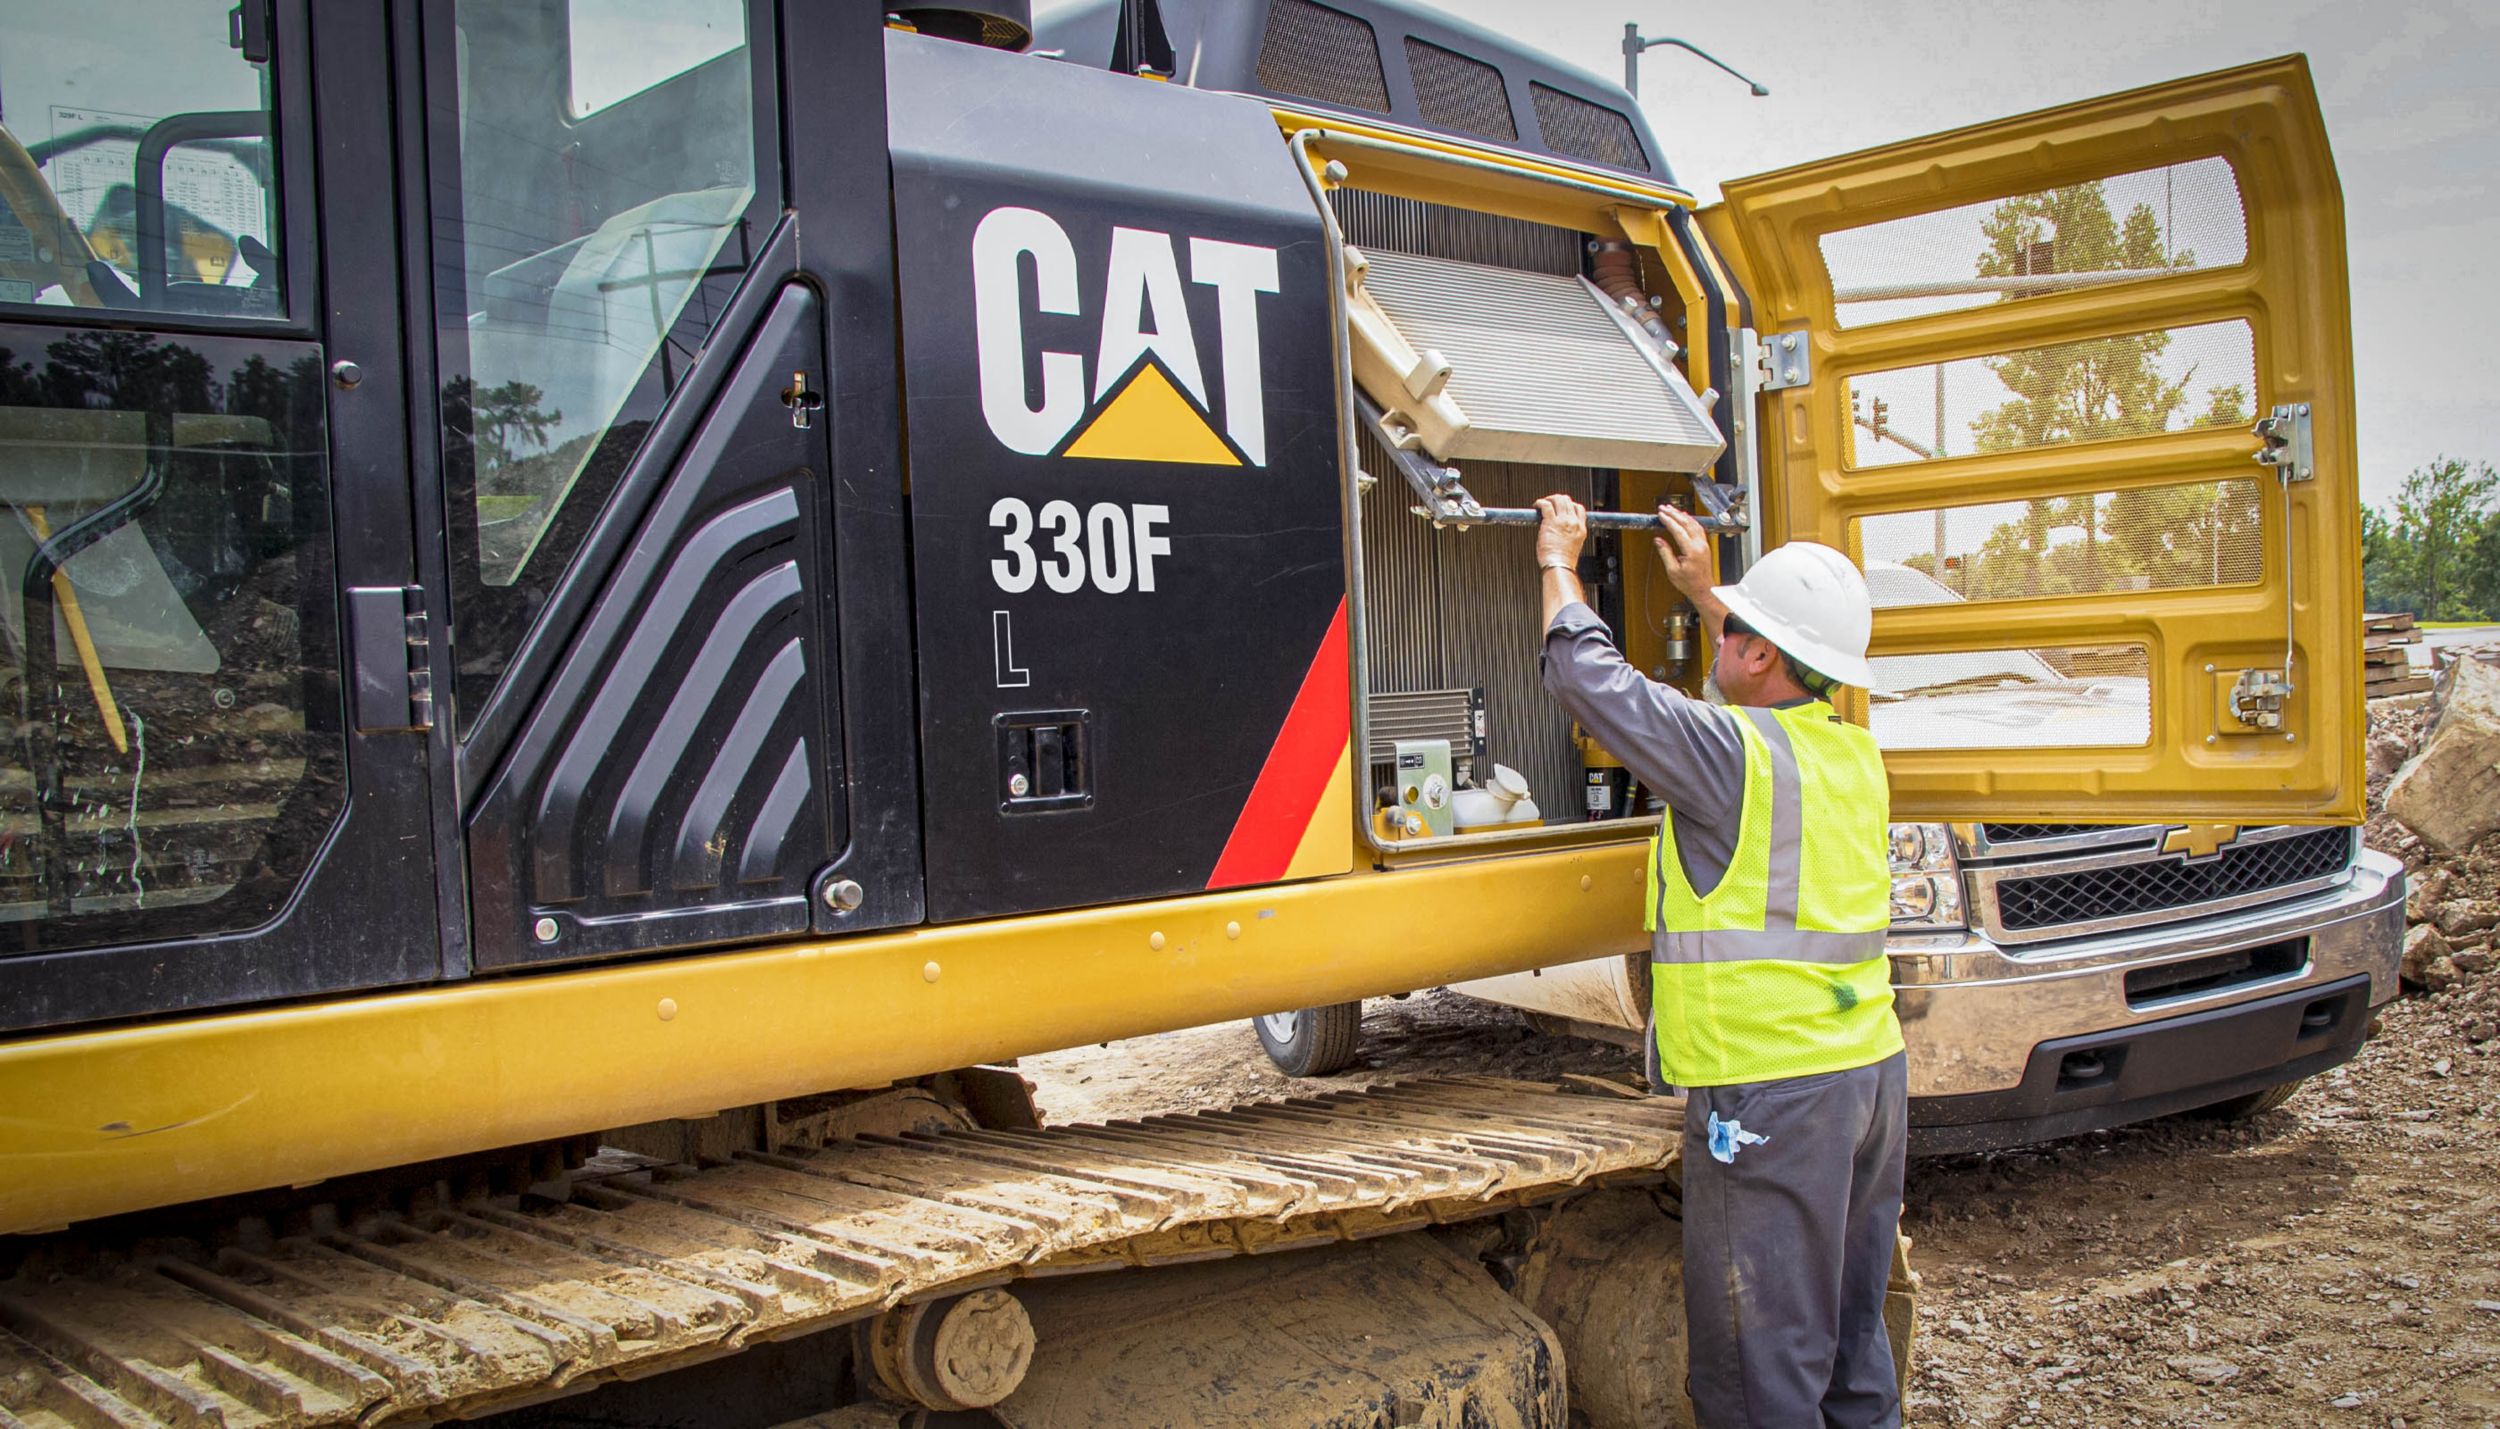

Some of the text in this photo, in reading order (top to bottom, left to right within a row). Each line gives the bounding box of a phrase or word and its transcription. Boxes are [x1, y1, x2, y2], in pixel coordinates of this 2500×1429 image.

[971, 206, 1280, 467] CAT
[989, 497, 1171, 594] 330F
[993, 611, 1030, 687] L
[1588, 772, 1604, 783] CAT
